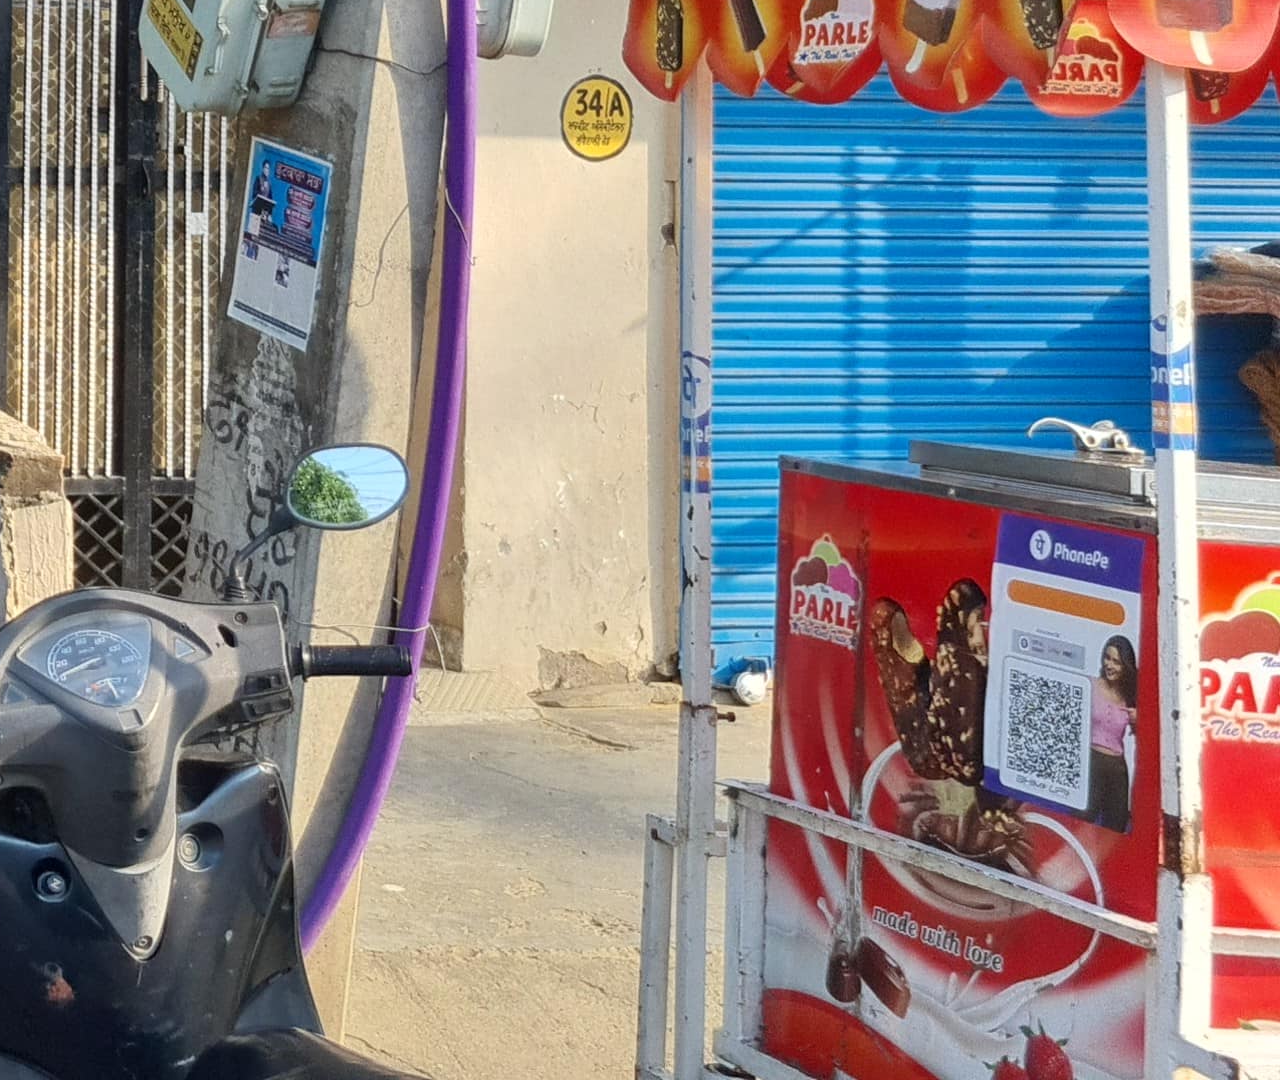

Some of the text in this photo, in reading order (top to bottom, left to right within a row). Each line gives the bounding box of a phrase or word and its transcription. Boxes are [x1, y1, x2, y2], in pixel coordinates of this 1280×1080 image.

[804, 20, 870, 47] PARLE
[1053, 542, 1110, 570] PhonePe
[792, 589, 858, 631] PARLE
[1210, 719, 1280, 739] The Rea
[873, 906, 1004, 973] made with love
